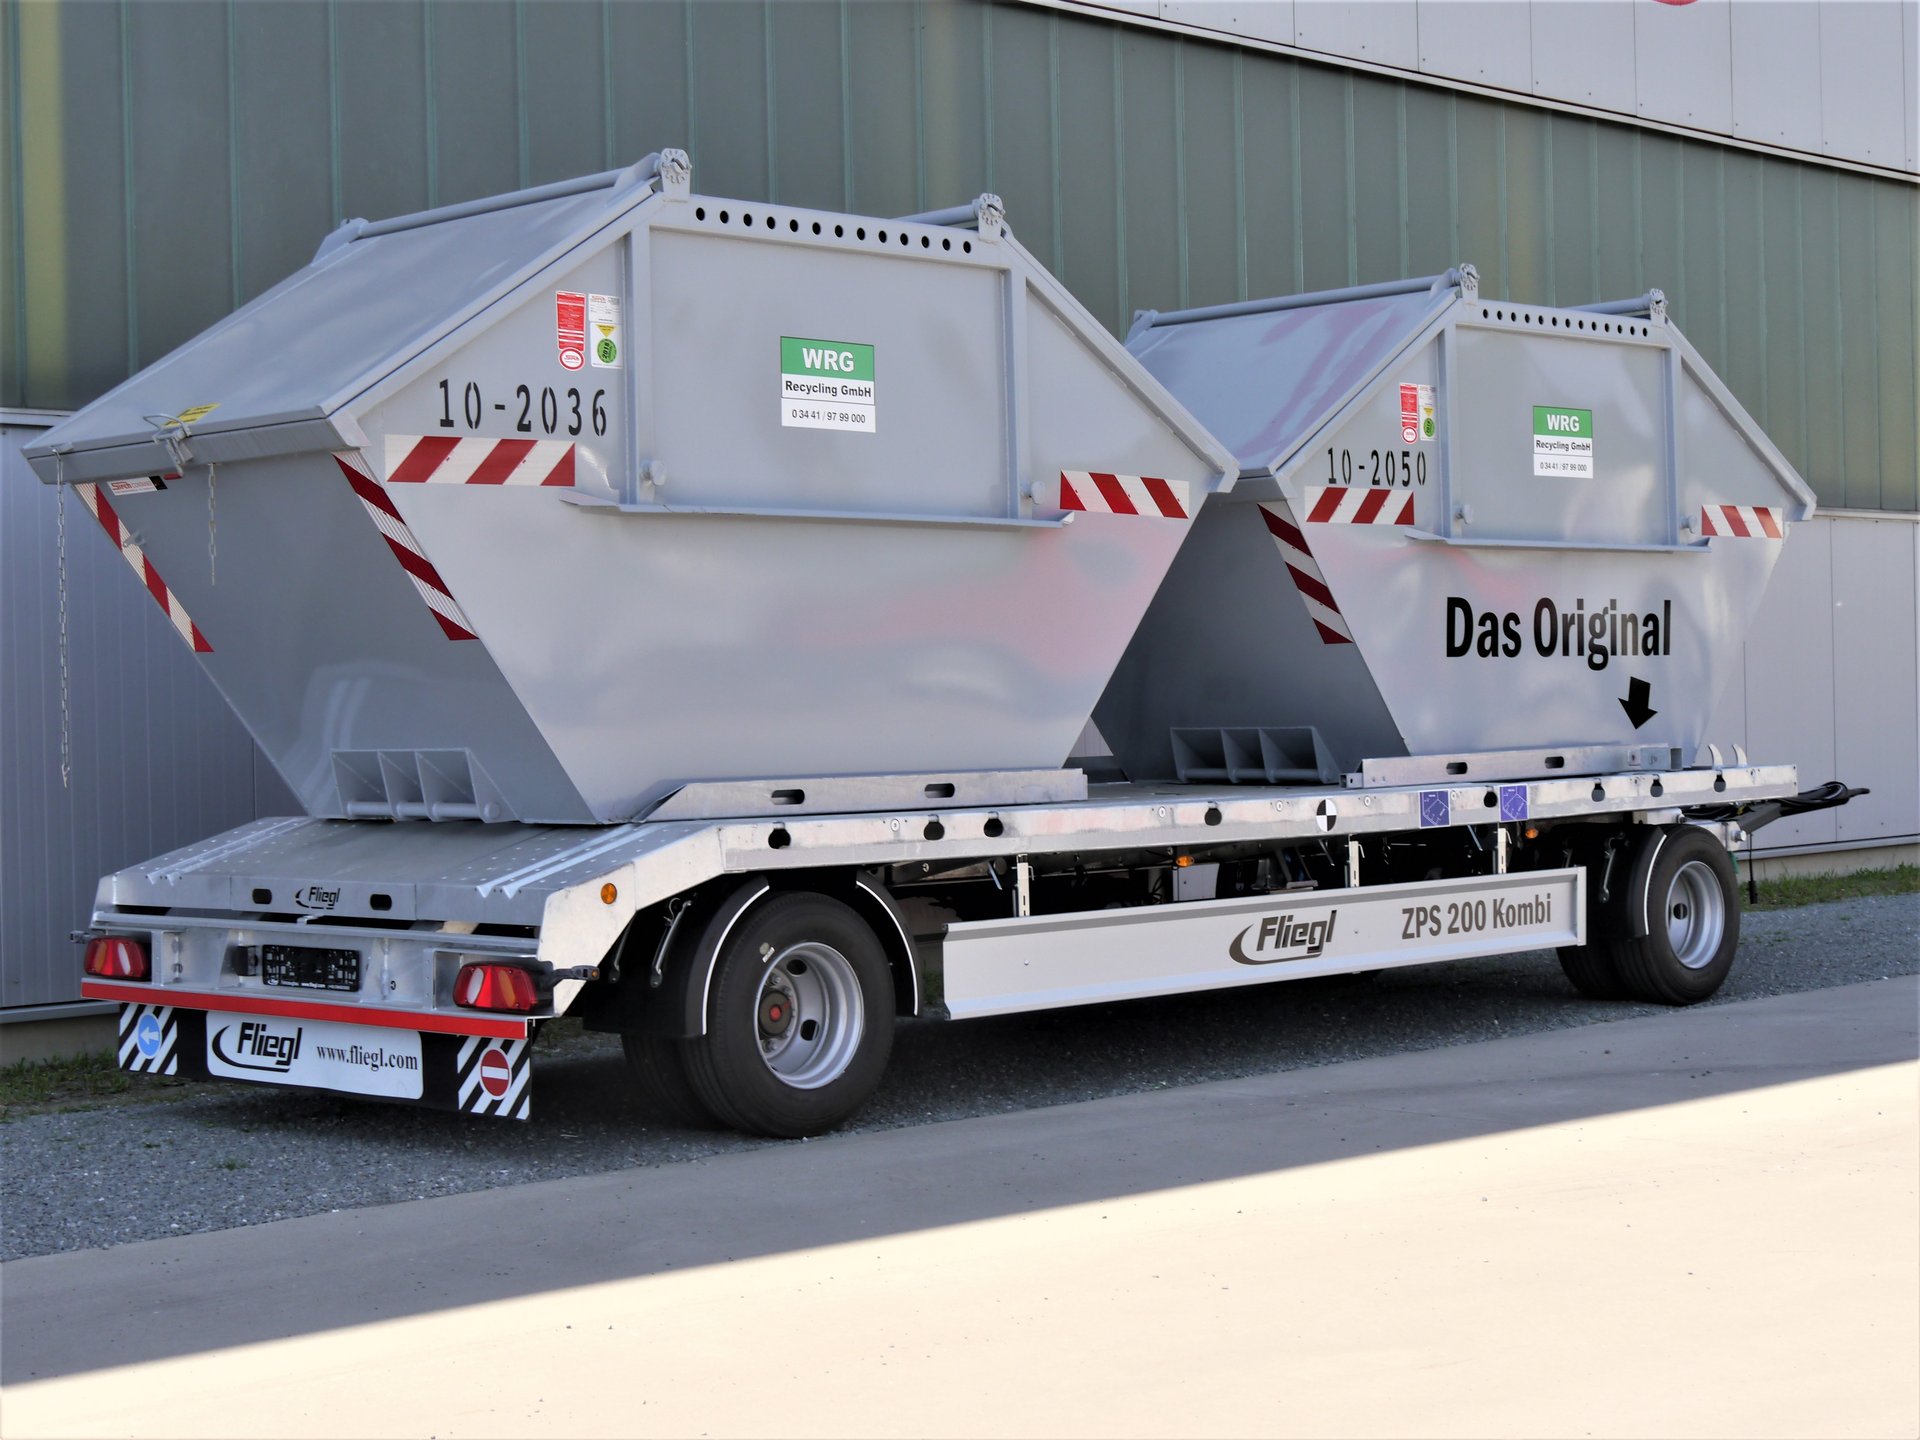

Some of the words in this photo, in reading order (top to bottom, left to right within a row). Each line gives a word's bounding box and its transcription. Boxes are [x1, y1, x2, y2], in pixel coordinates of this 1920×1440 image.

[802, 347, 854, 372] WRG
[785, 380, 837, 397] Recycling
[841, 385, 872, 398] GmbH
[439, 378, 607, 437] 10-2036
[792, 409, 798, 419] 0
[799, 410, 809, 419] 34
[811, 410, 820, 420] 41
[827, 411, 837, 421] 97
[839, 412, 849, 422] 99
[851, 413, 866, 423] 000
[1547, 414, 1580, 432] WRG
[1536, 440, 1569, 451] Recycling
[1571, 442, 1591, 451] GmbH
[1328, 447, 1426, 487] 10-2050
[1446, 597, 1522, 658] Das
[1533, 597, 1671, 671] Original
[309, 886, 341, 907] Fliegl
[1256, 909, 1337, 955] Fliegl
[1402, 906, 1442, 940] ZPS
[1448, 899, 1486, 935] 200
[1492, 893, 1552, 929] Kombi
[237, 1021, 303, 1067] Fliegl
[316, 1044, 418, 1072] www.fliegl.com
